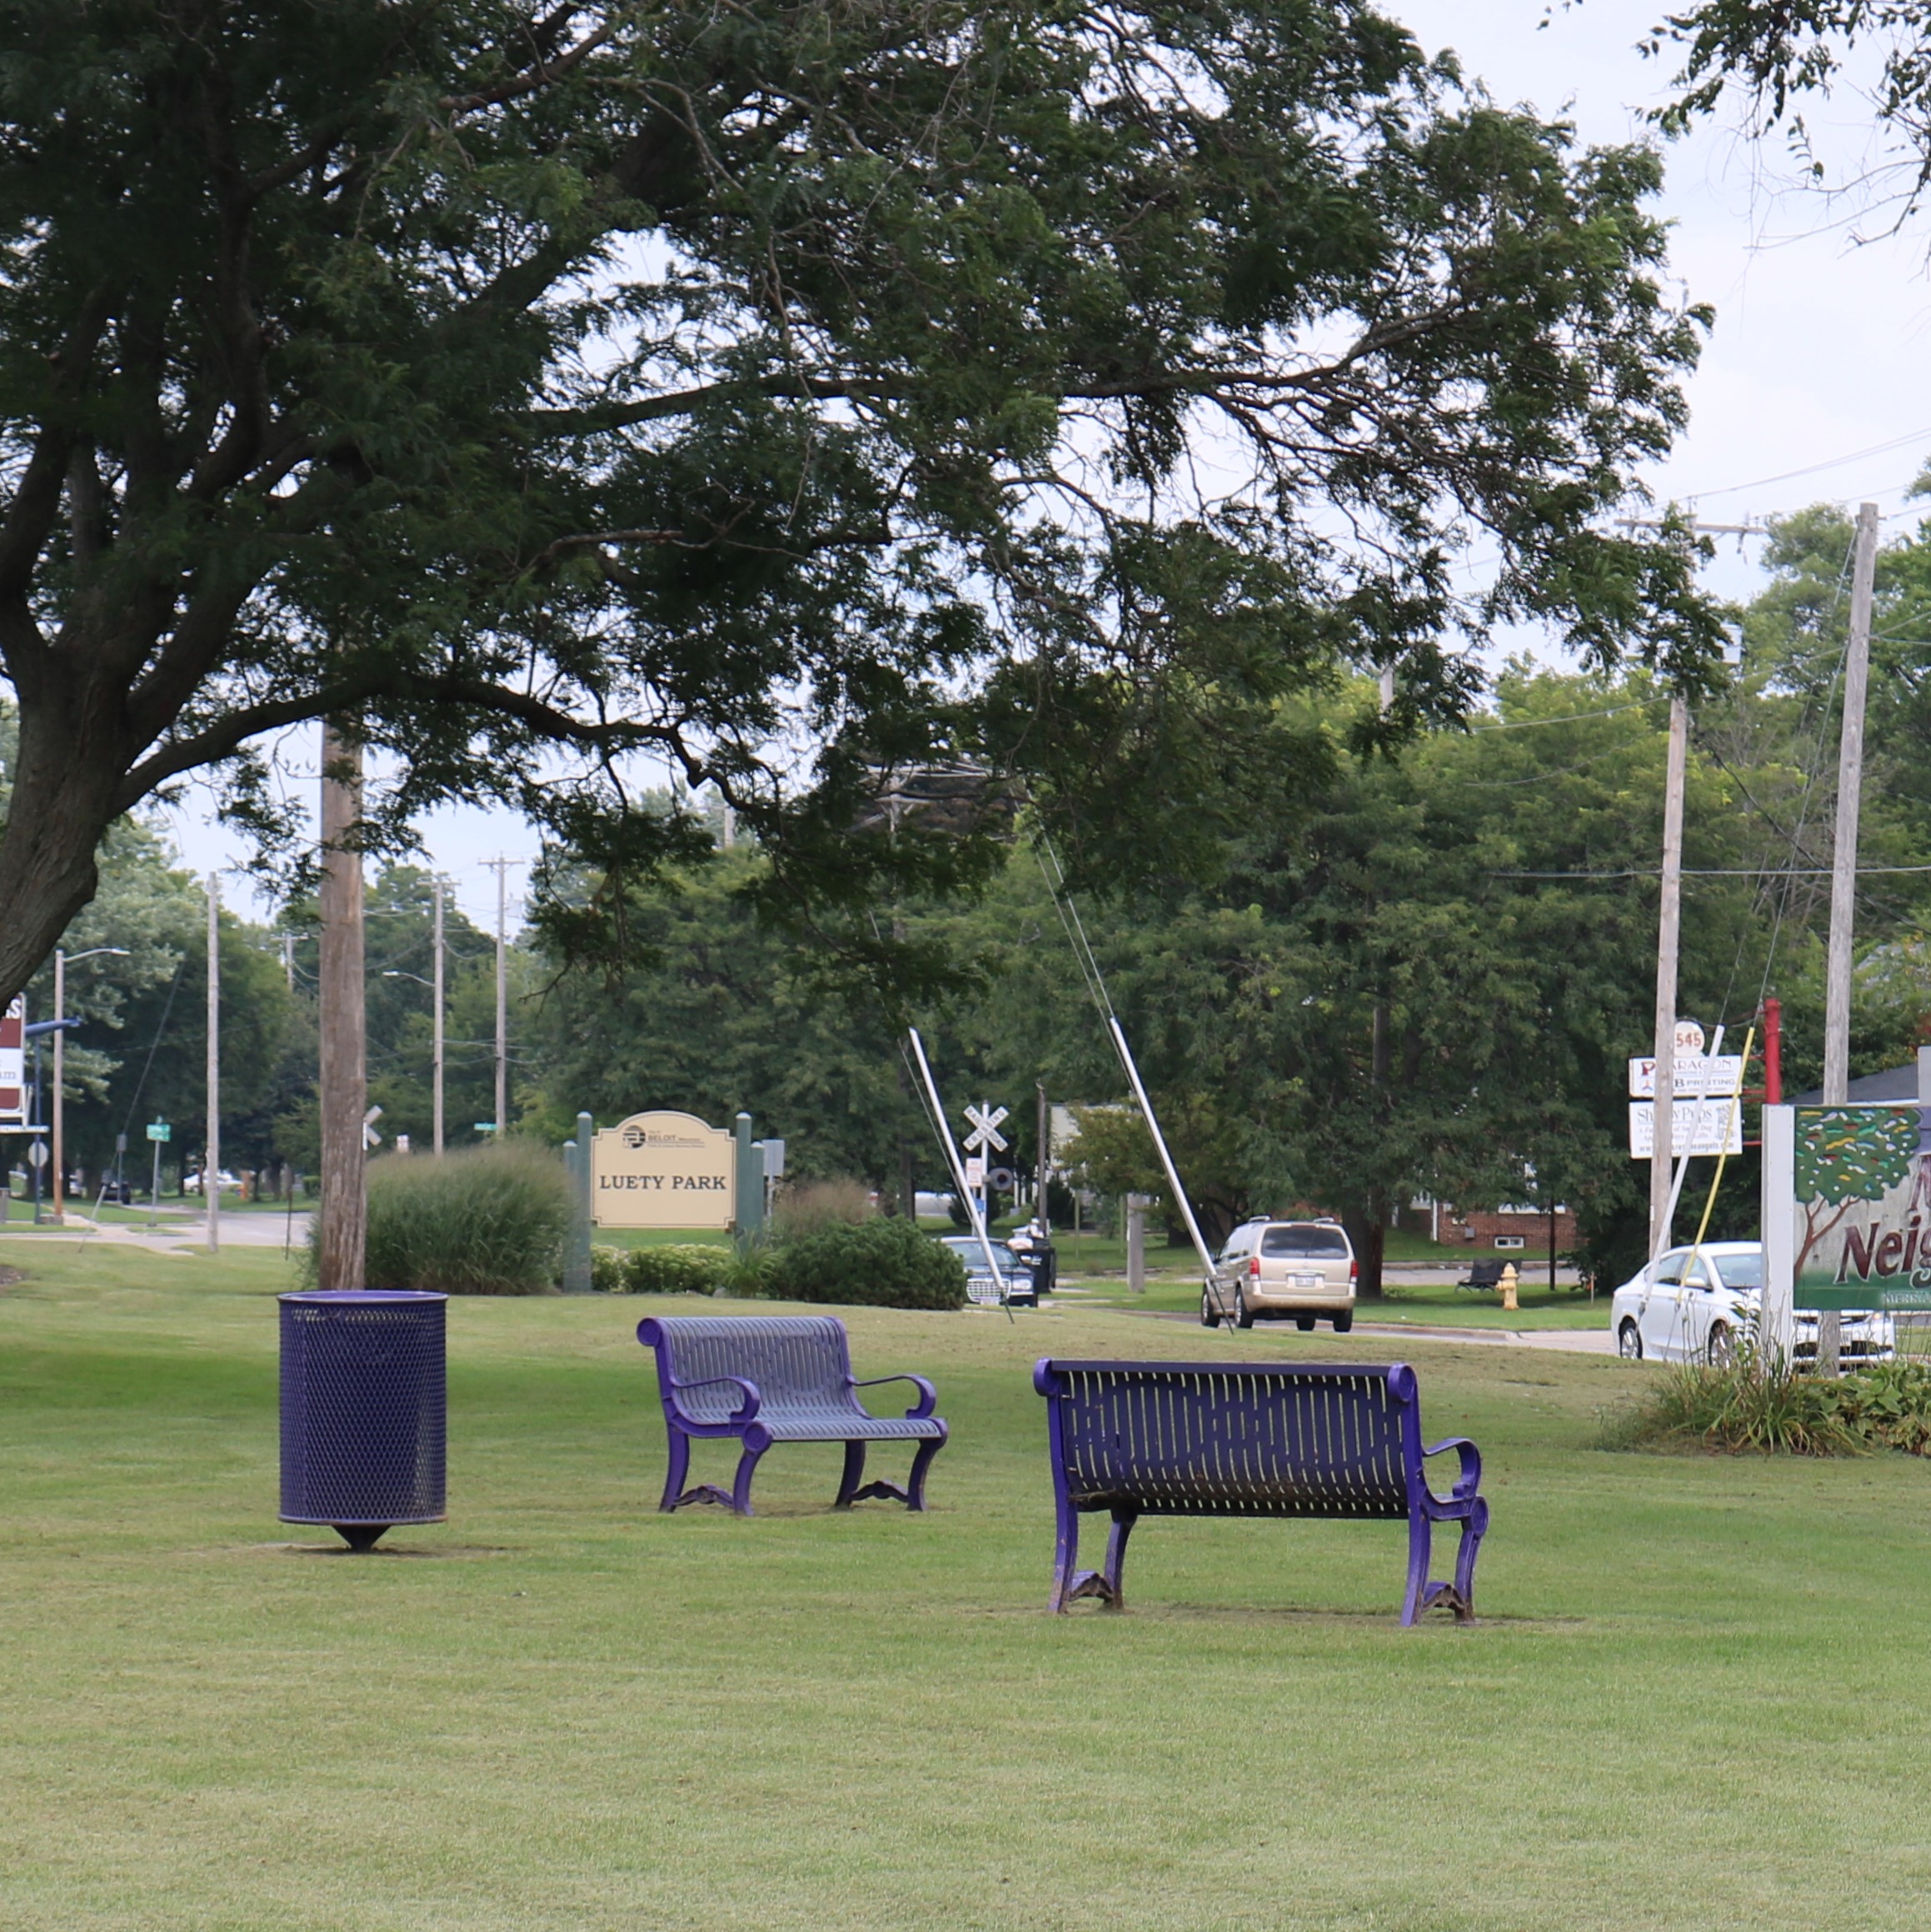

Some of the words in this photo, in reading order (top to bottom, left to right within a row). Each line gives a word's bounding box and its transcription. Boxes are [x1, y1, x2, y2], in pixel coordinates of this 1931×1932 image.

[1677, 1032, 1702, 1047] 545
[1641, 1060, 1732, 1076] PRAGON
[966, 1108, 1006, 1148] CROSSING
[600, 1176, 665, 1190] LUETY
[672, 1176, 726, 1190] PARK
